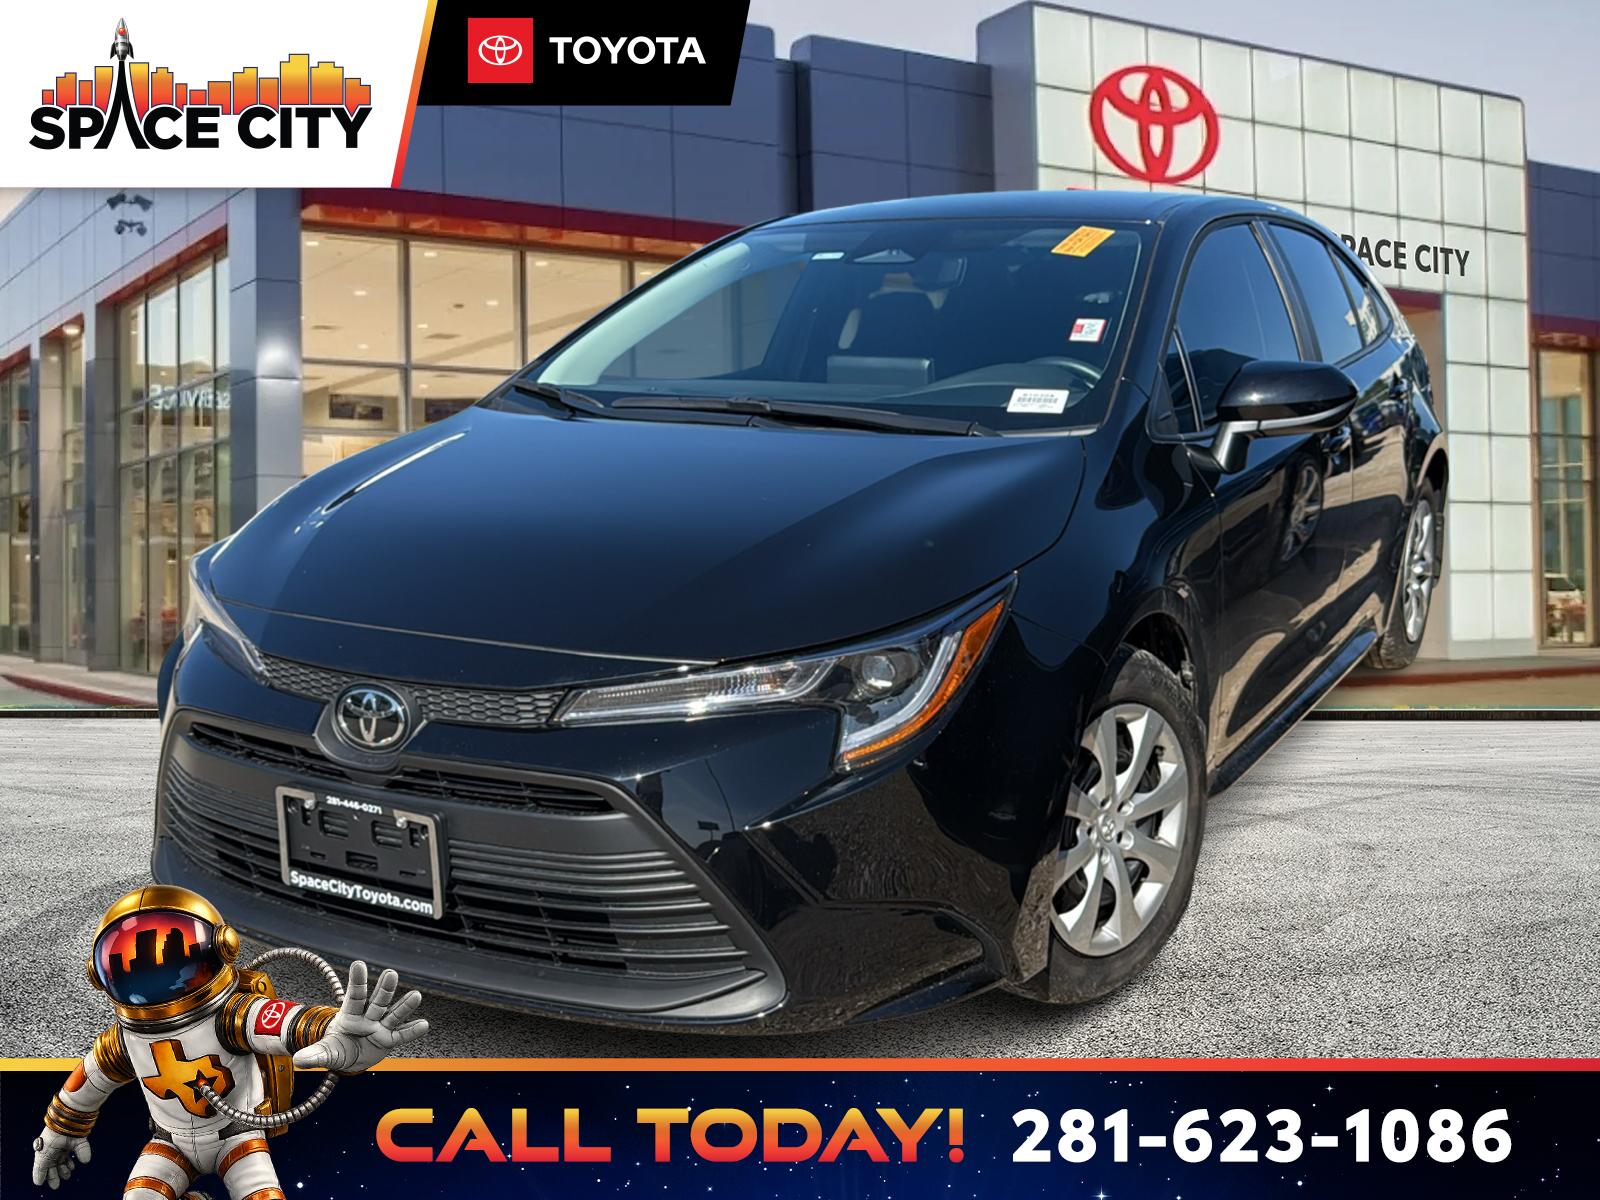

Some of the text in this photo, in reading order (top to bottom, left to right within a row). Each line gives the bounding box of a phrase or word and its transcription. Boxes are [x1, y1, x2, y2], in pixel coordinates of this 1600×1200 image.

[1334, 233, 1470, 277] PACE CITY
[289, 870, 434, 915] SpaceCityToyota.com
